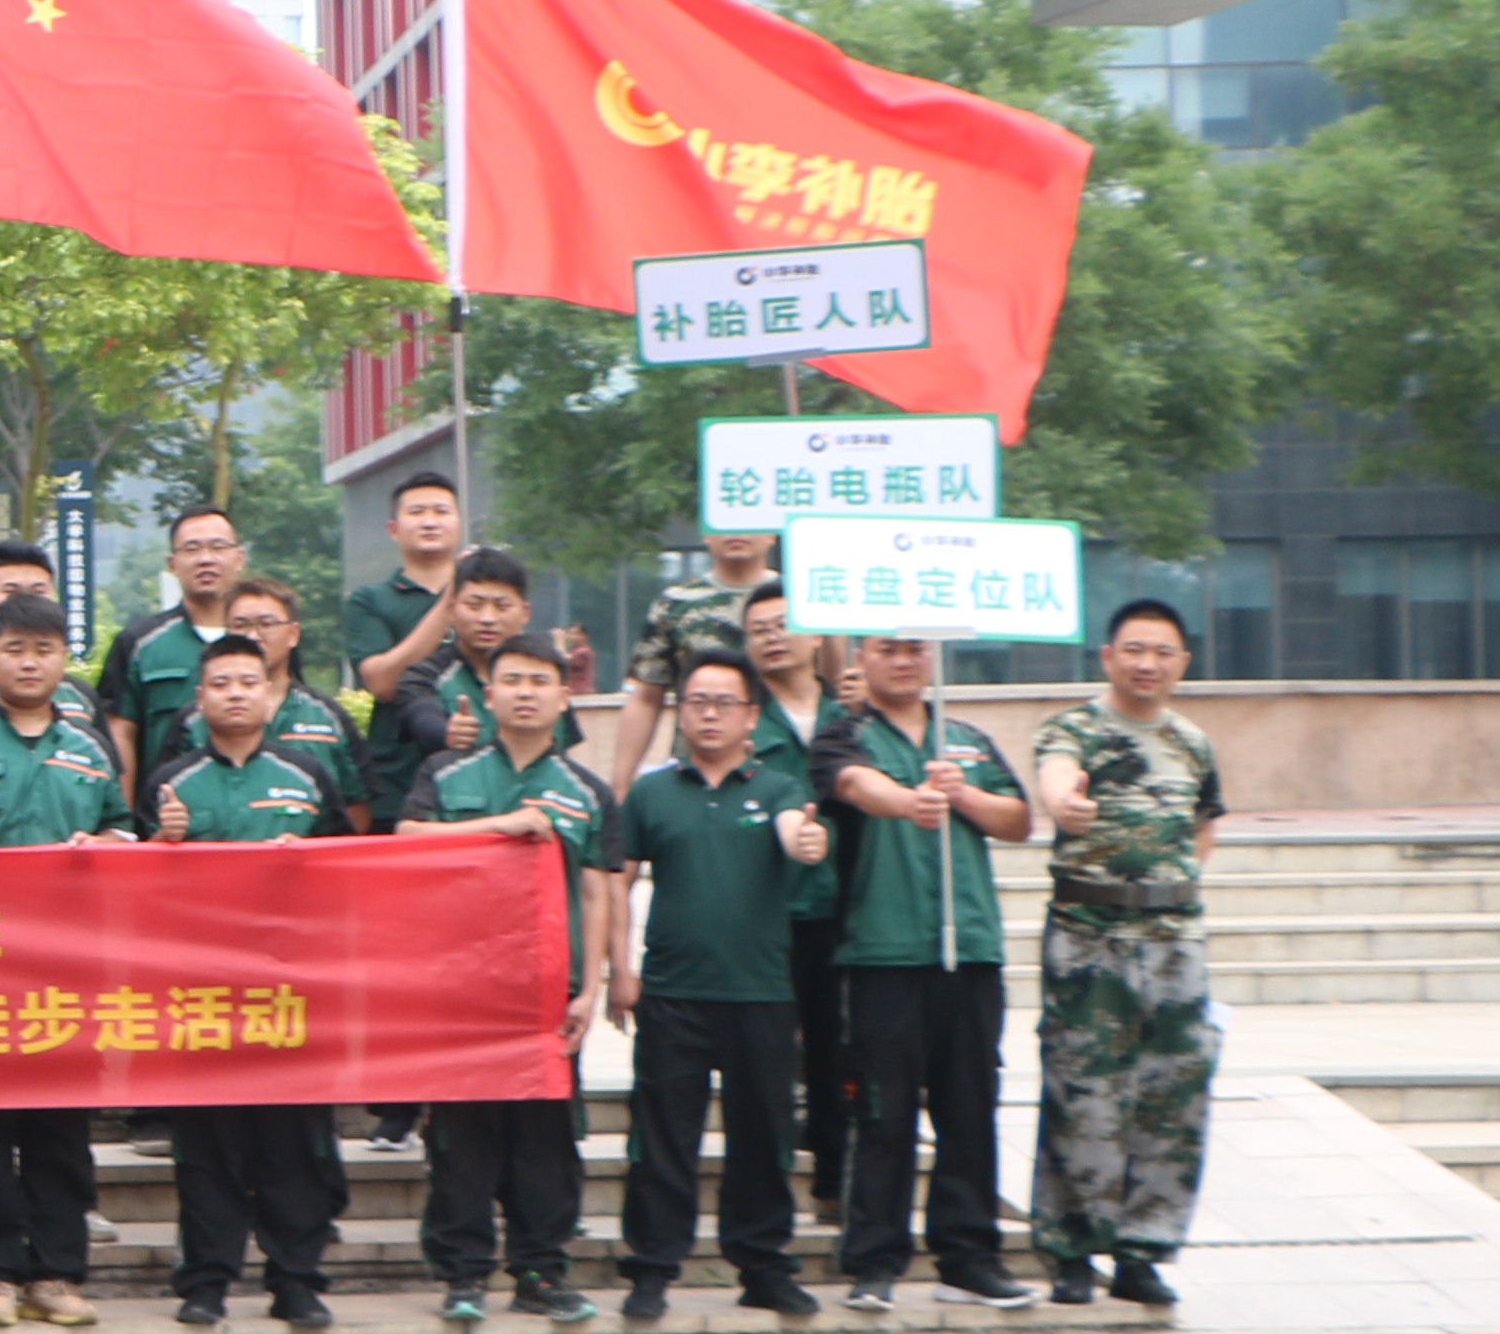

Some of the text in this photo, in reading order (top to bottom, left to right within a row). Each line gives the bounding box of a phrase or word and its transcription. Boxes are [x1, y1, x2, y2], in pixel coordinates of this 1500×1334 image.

[652, 287, 912, 342] 补胎匠人队
[719, 463, 982, 508] 轮胎电瓶队
[806, 564, 1065, 612] 底盘定位队
